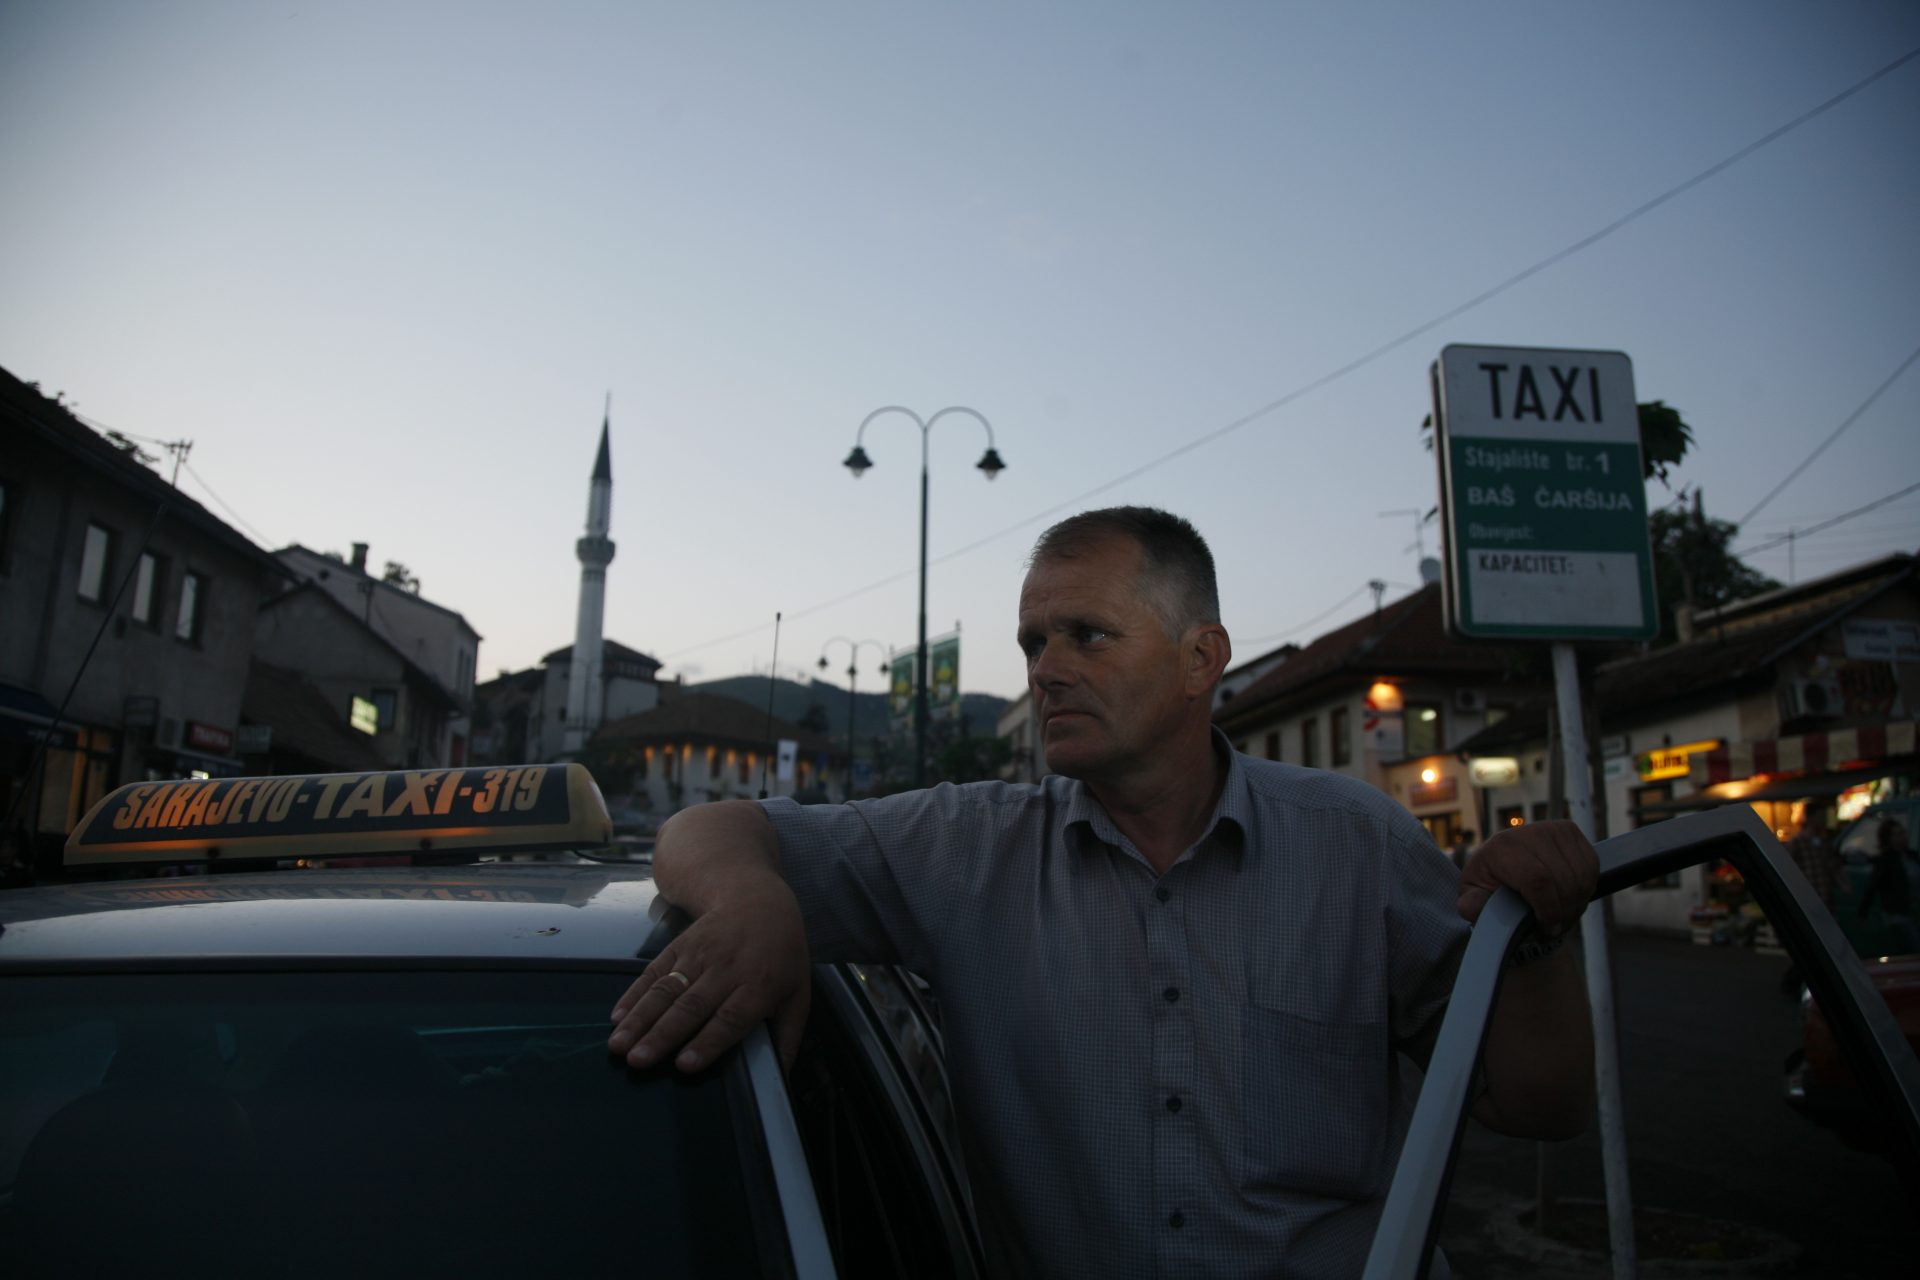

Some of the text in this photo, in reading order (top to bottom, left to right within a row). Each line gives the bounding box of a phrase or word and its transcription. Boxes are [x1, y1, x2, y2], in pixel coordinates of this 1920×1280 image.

[1479, 363, 1603, 423] TAXI
[1595, 451, 1611, 475] 1
[1467, 484, 1633, 511] BAŠ ČARŠIJA
[1479, 554, 1574, 575] KAPACITET:
